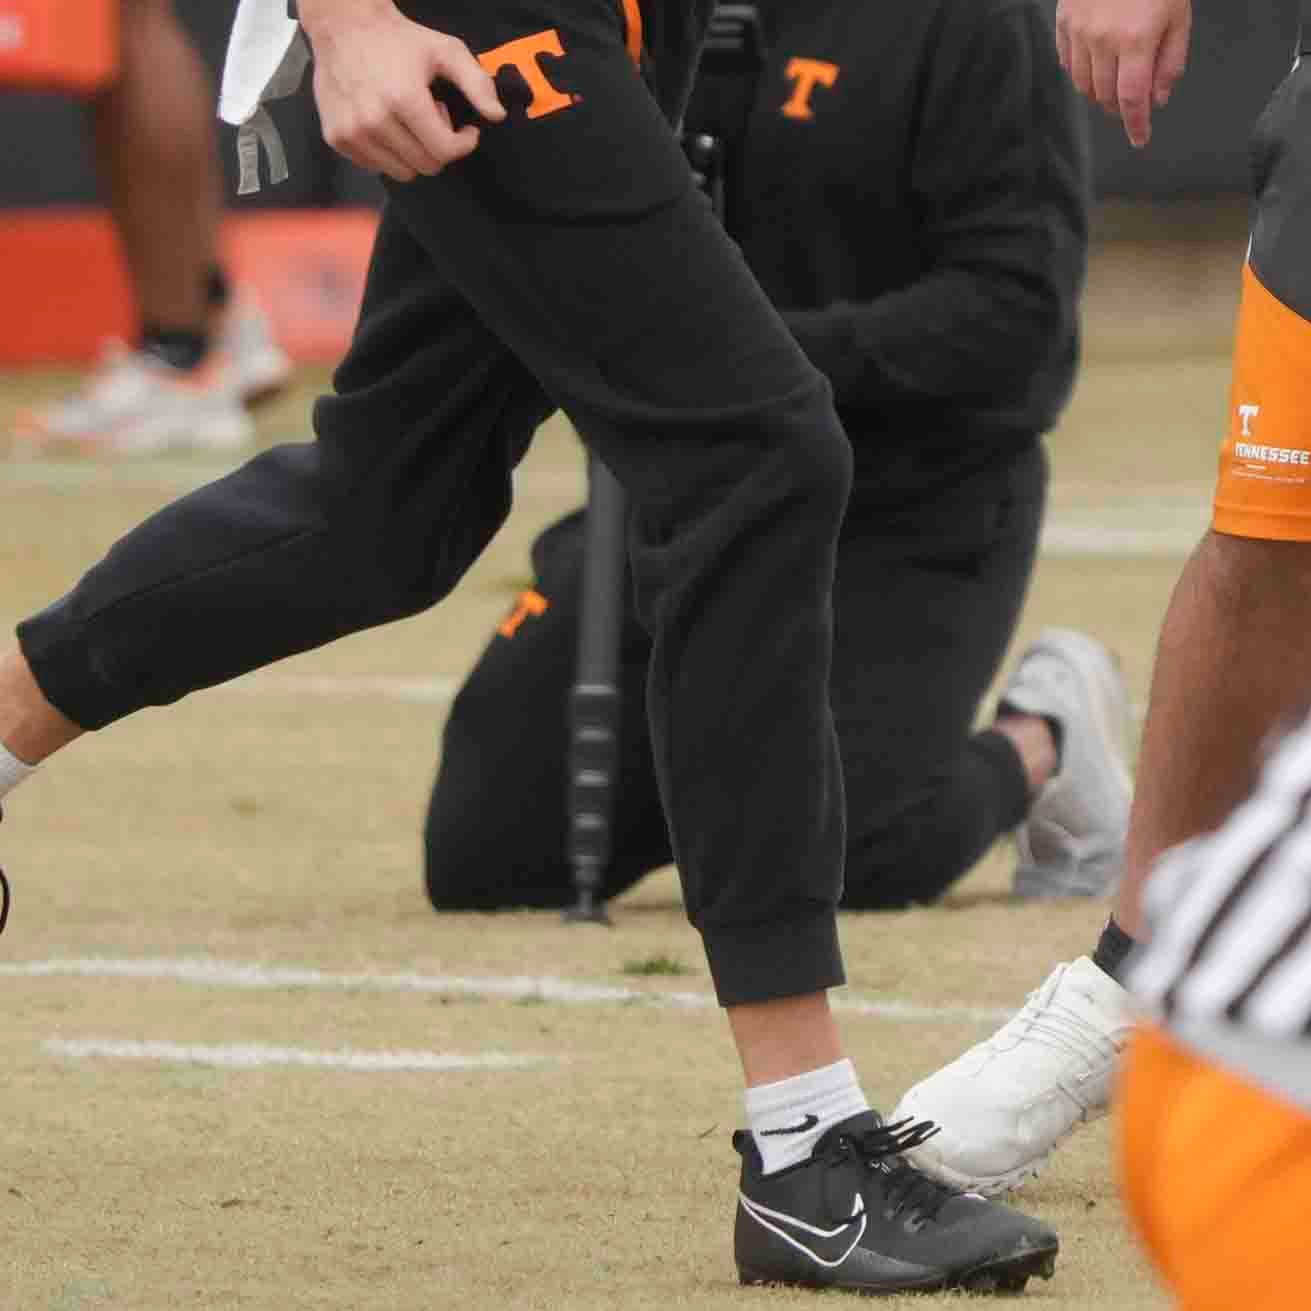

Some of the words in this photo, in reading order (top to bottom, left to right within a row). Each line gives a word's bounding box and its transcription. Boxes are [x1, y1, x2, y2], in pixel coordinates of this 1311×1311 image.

[474, 28, 573, 120] T
[782, 57, 840, 121] T
[1238, 404, 1259, 437] T
